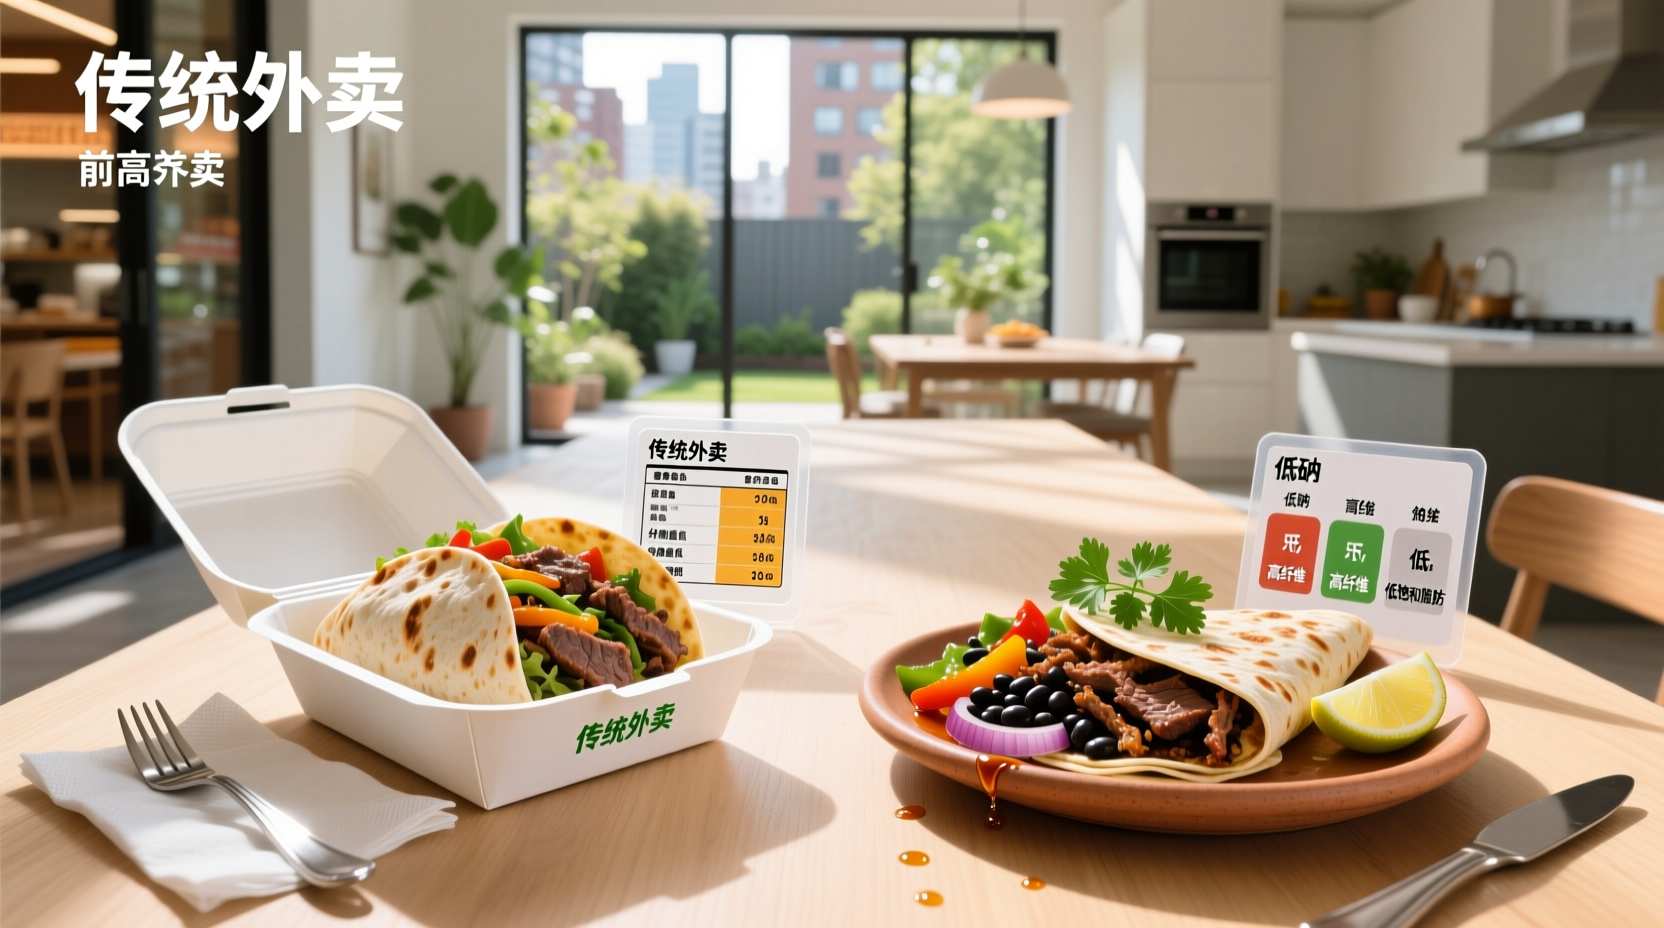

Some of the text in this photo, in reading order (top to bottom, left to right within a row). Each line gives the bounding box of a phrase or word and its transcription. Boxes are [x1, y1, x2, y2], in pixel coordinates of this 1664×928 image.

[648, 438, 728, 463] 传统外卖
[575, 703, 676, 755] 传统外卖
